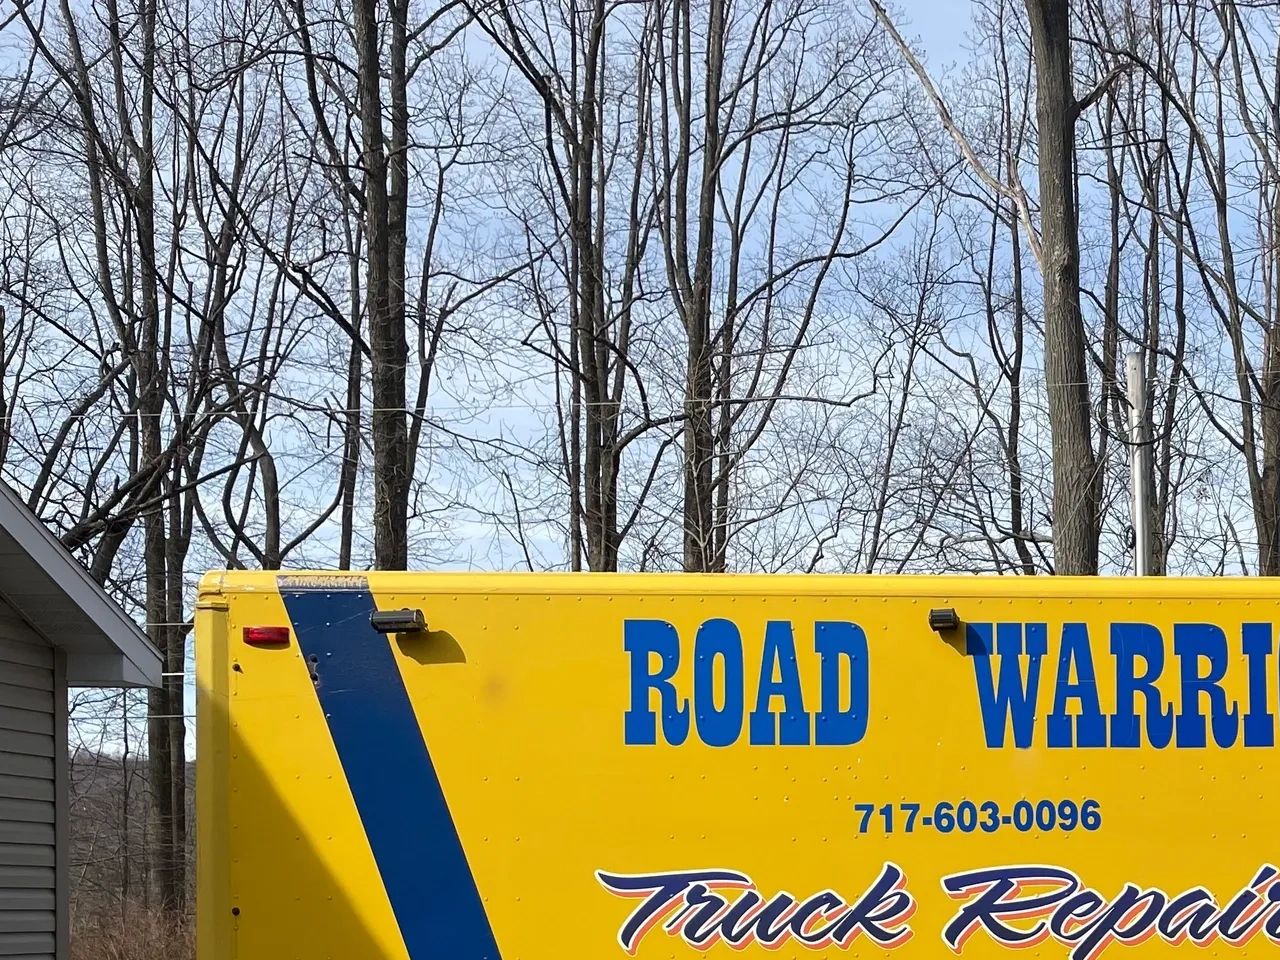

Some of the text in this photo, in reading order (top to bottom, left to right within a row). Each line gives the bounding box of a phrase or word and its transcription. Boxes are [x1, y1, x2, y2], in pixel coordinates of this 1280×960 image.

[623, 618, 870, 748] ROAD
[853, 799, 1103, 835] 717-603-0096
[596, 862, 915, 957] Truck
